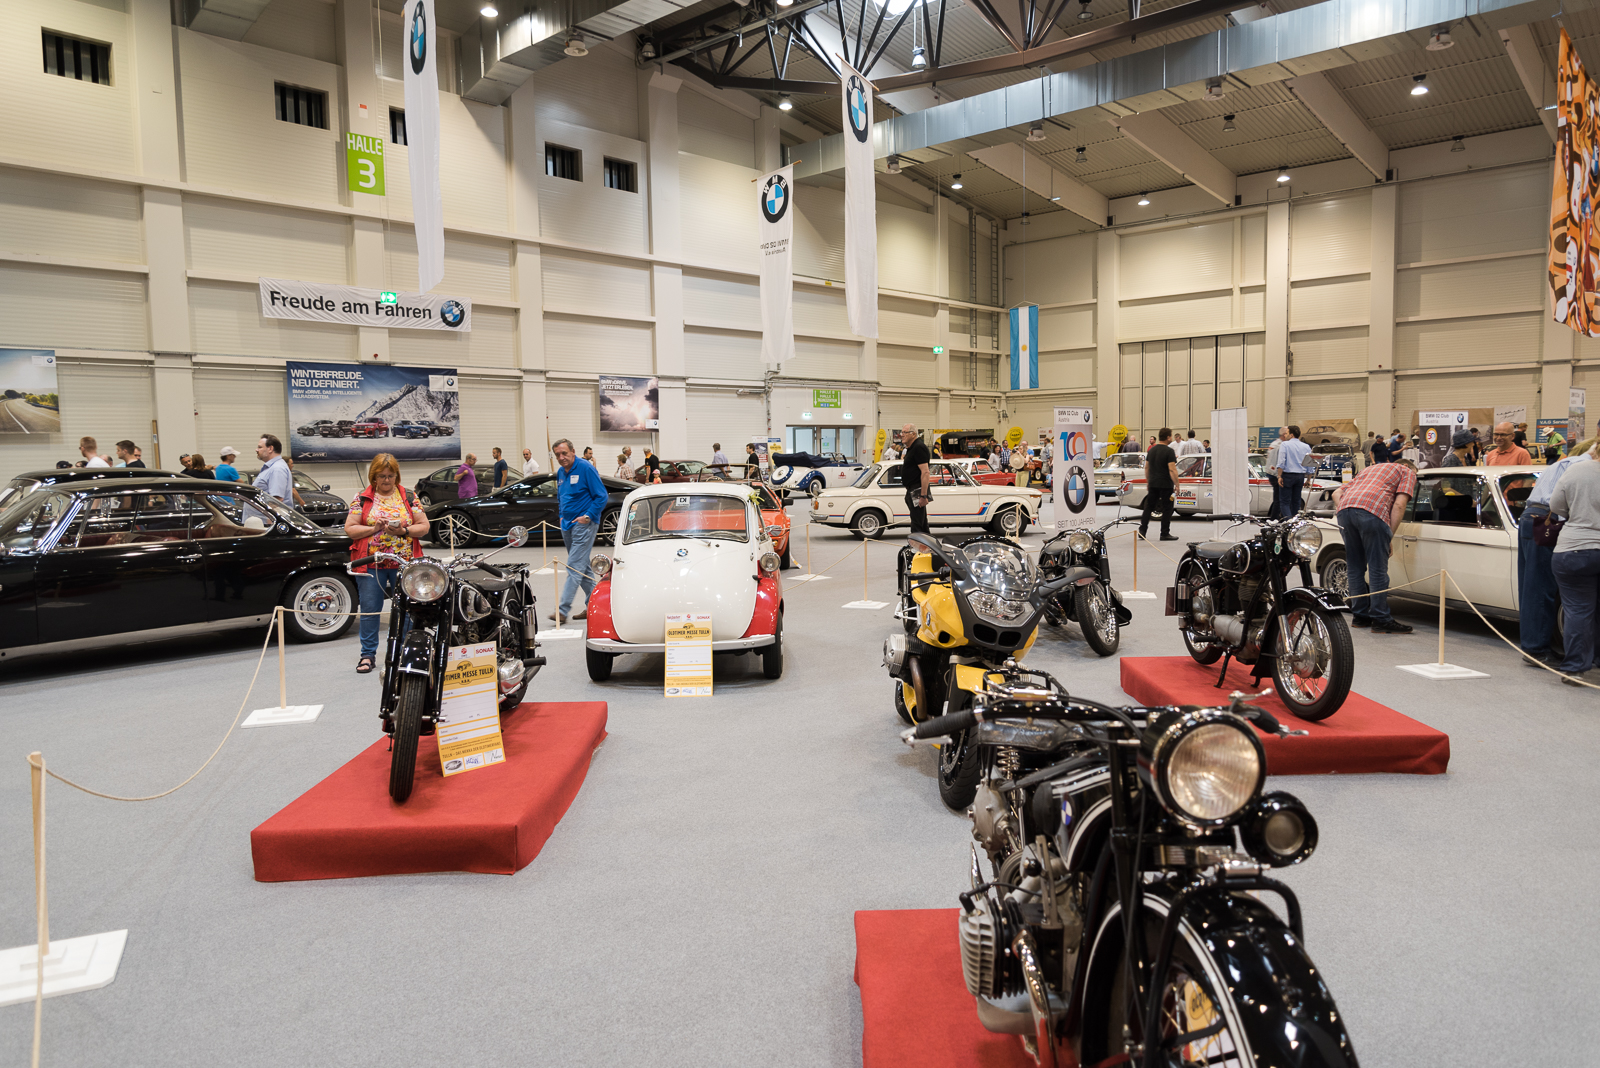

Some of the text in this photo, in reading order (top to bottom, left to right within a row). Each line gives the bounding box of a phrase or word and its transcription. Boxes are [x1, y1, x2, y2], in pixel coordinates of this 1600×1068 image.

[347, 133, 382, 155] HALLE
[358, 158, 376, 188] 3
[270, 290, 432, 319] Freude am Fahren
[290, 369, 364, 380] WINTERFREUDE.
[292, 379, 360, 389] NEU DEFINIERT.
[462, 670, 477, 678] MESSE
[479, 667, 493, 675] TULLN
